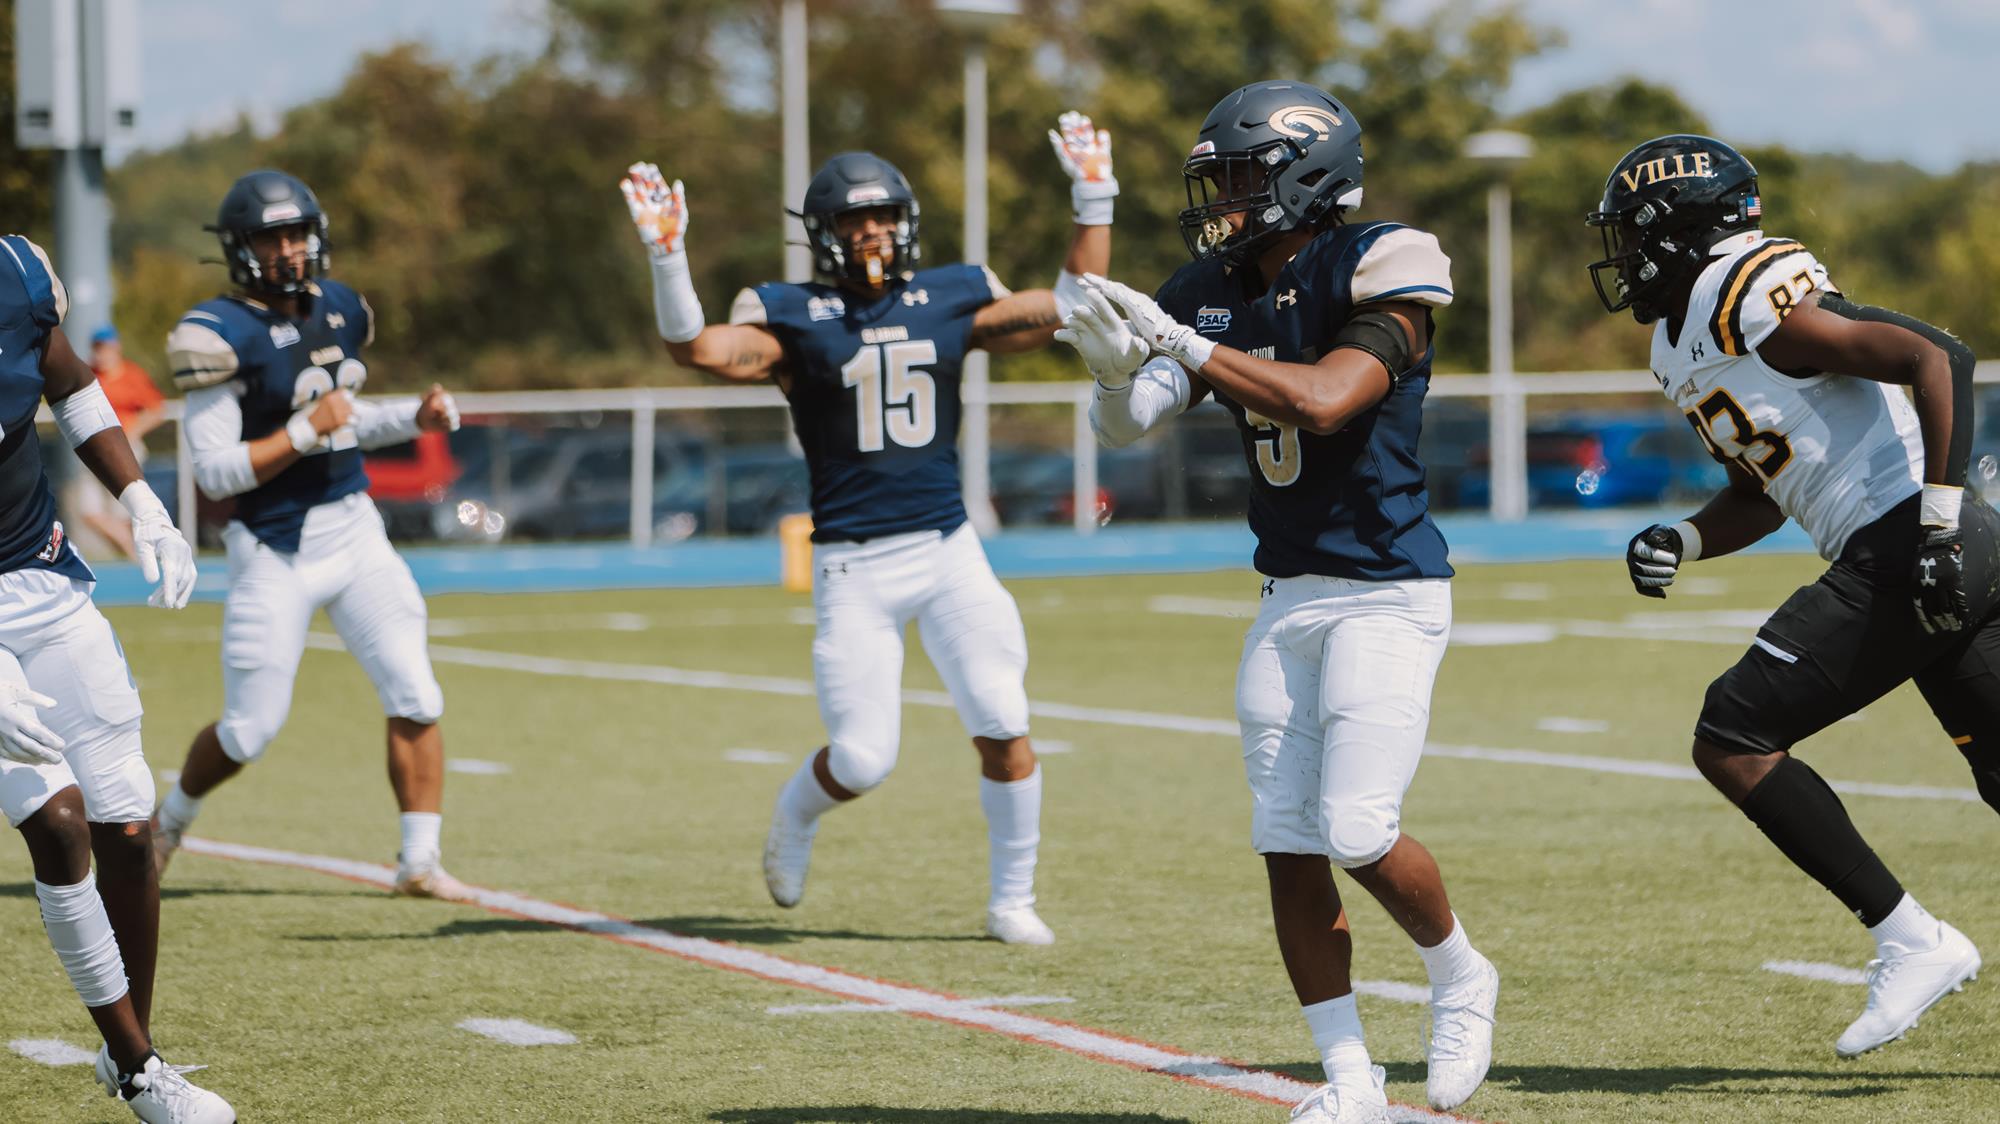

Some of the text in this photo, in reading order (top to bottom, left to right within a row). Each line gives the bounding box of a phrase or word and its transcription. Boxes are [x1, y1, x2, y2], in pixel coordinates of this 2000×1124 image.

[1620, 152, 1718, 193] VILLE
[1198, 314, 1230, 326] PSAC
[841, 339, 938, 452] 15
